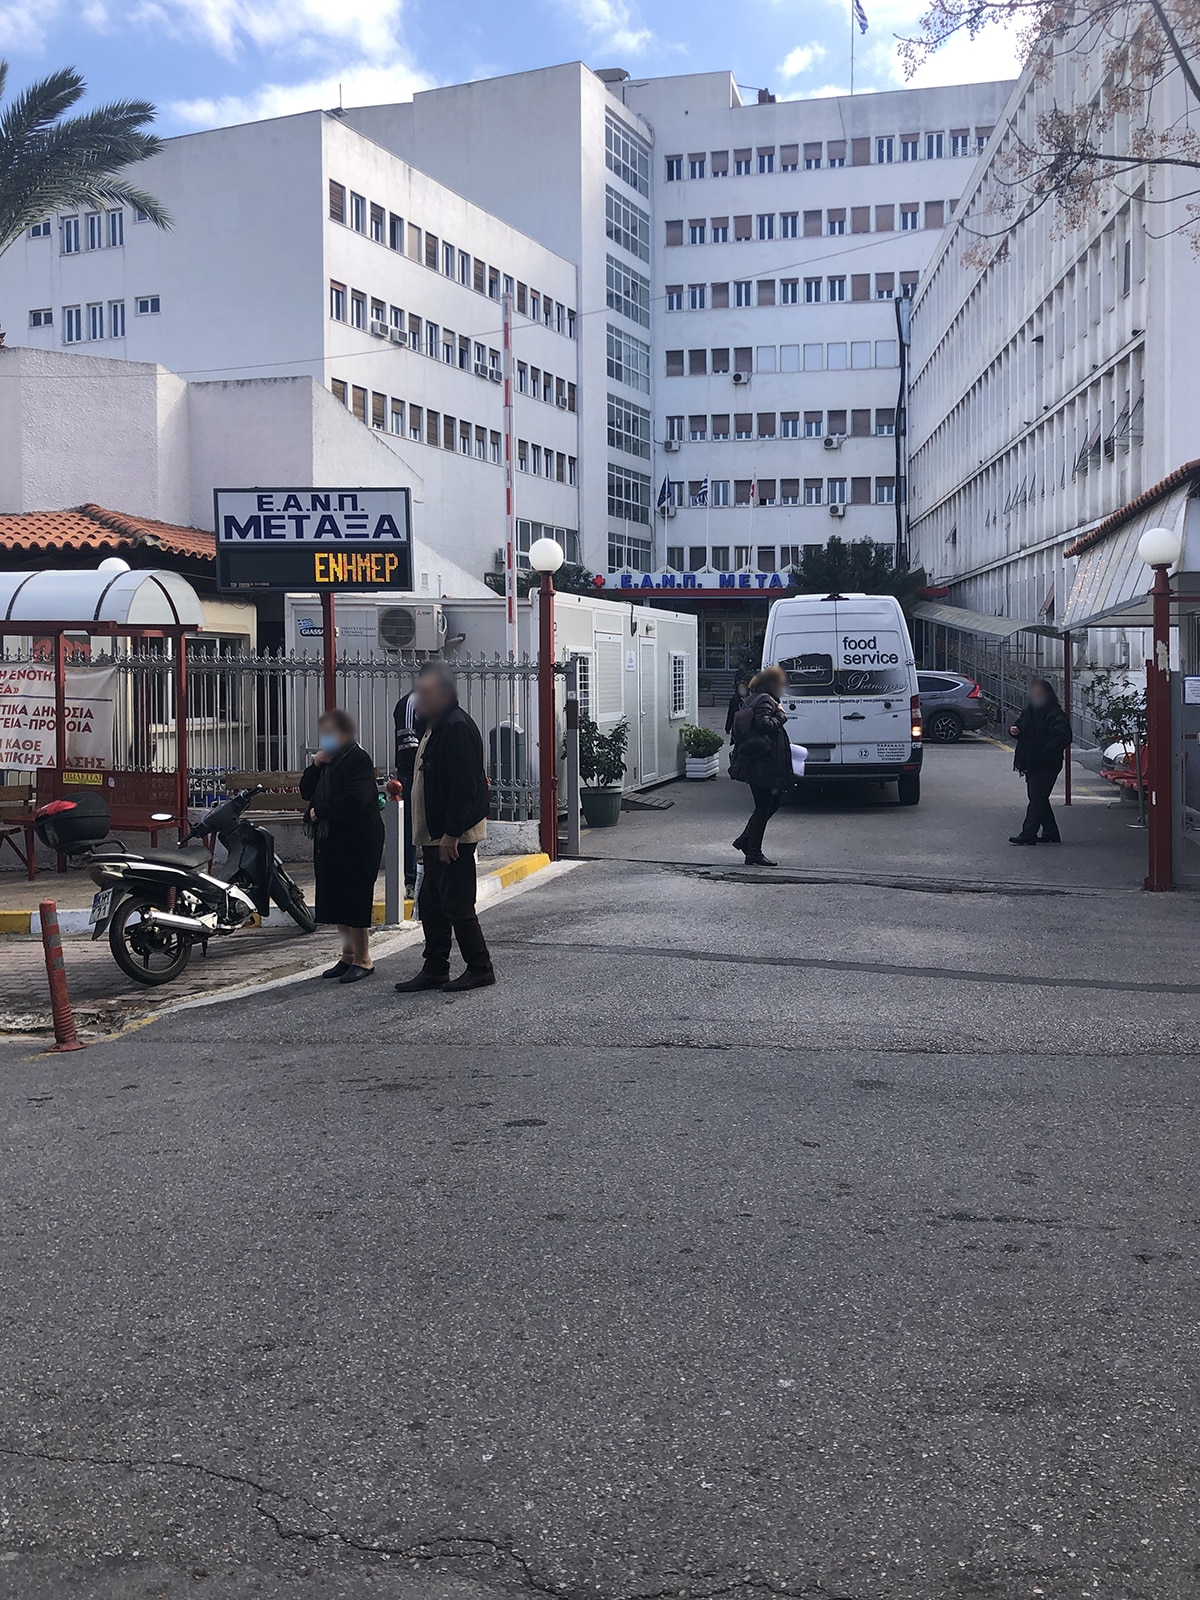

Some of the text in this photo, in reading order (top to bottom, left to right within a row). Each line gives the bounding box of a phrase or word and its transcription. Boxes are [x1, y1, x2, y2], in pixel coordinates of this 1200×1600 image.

[257, 494, 365, 512] Ε.Α.Ν.Π.
[223, 514, 402, 540] ΜΕΤΑΞΑ
[314, 553, 399, 583] ΕΝΗΜΕΡ
[621, 574, 703, 588] Ε.Α.Ν.Π.
[842, 636, 877, 650] food
[843, 650, 899, 665] service
[5, 738, 42, 752] ΚΑΘΕ
[46, 755, 106, 769] ΔΑΣΗΣ
